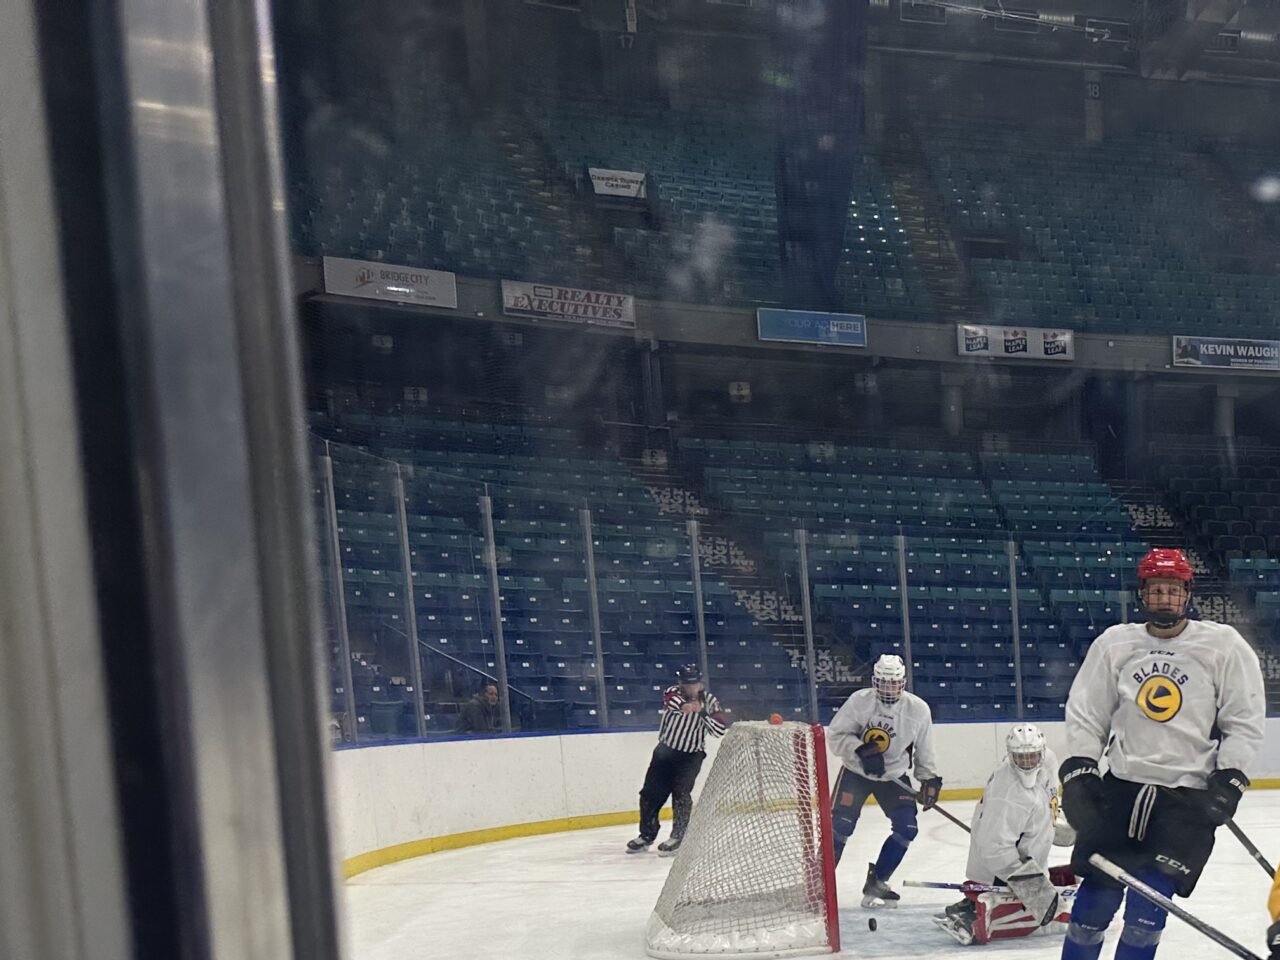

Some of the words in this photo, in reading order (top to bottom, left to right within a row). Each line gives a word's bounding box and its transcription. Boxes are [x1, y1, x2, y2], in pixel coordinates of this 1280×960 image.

[1087, 82, 1100, 98] 18
[556, 287, 627, 309] REALTY
[512, 293, 623, 320] EXECUTIVES
[831, 320, 861, 333] HERE
[966, 336, 988, 345] MAPLE
[969, 342, 984, 350] LEAF
[1005, 338, 1026, 347] MAPLE
[1044, 341, 1065, 349] MAPLE
[1047, 346, 1062, 354] LEAF
[1200, 343, 1234, 356] KEVIN
[1236, 345, 1279, 358] WAUGH
[1133, 663, 1189, 686] BLADES
[1155, 854, 1190, 875] CCM
